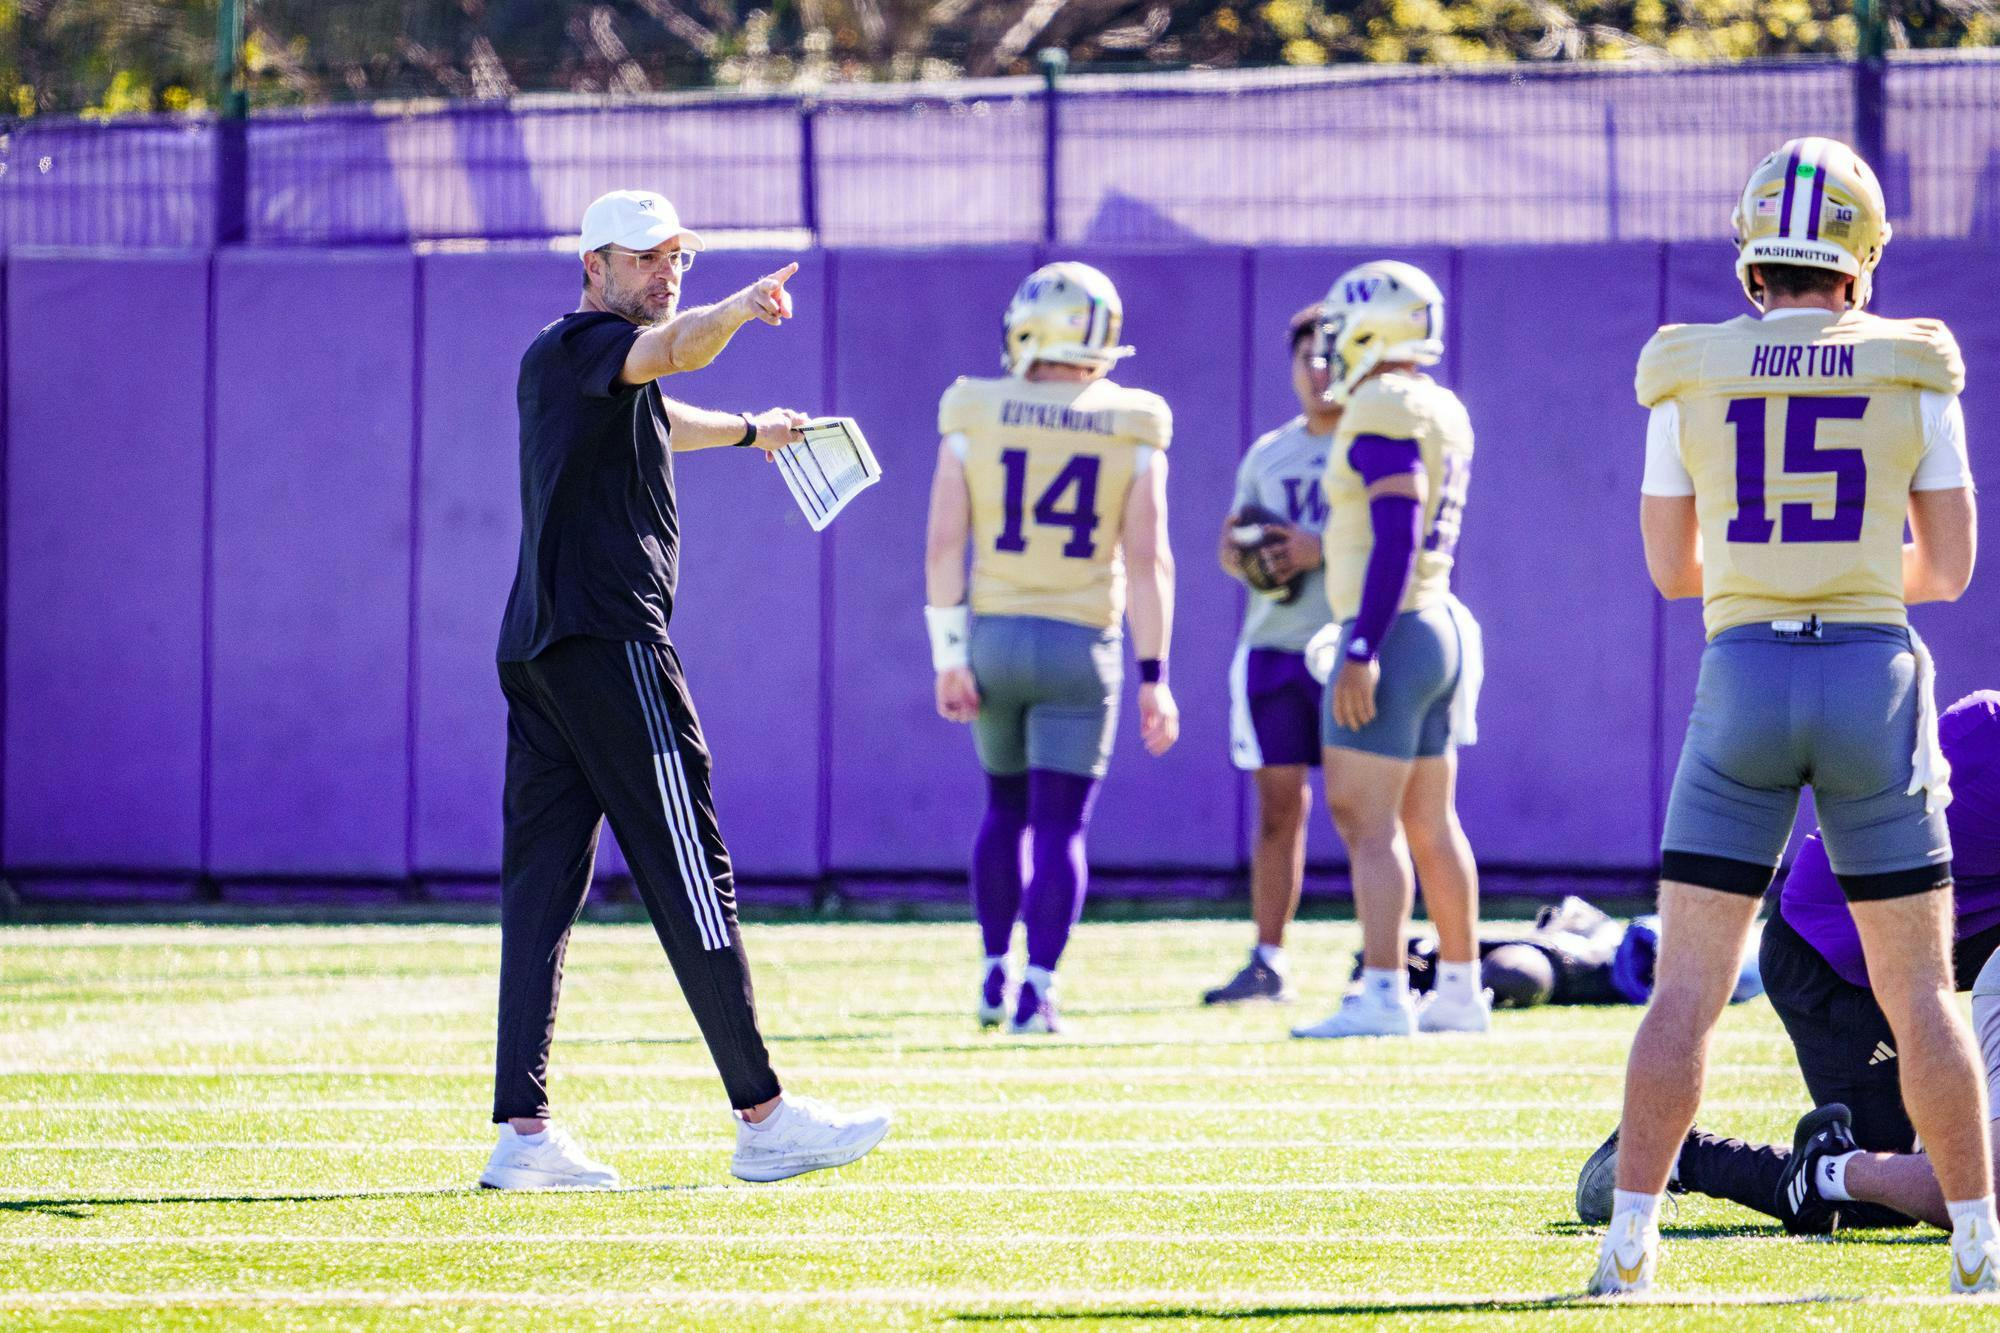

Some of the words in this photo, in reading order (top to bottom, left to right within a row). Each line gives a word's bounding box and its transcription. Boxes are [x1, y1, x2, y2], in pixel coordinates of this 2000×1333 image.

[1754, 247, 1840, 264] WASHINGTON
[1344, 278, 1380, 304] W
[1750, 344, 1855, 377] HORTON
[1725, 396, 1871, 544] 15
[995, 447, 1102, 559] 14
